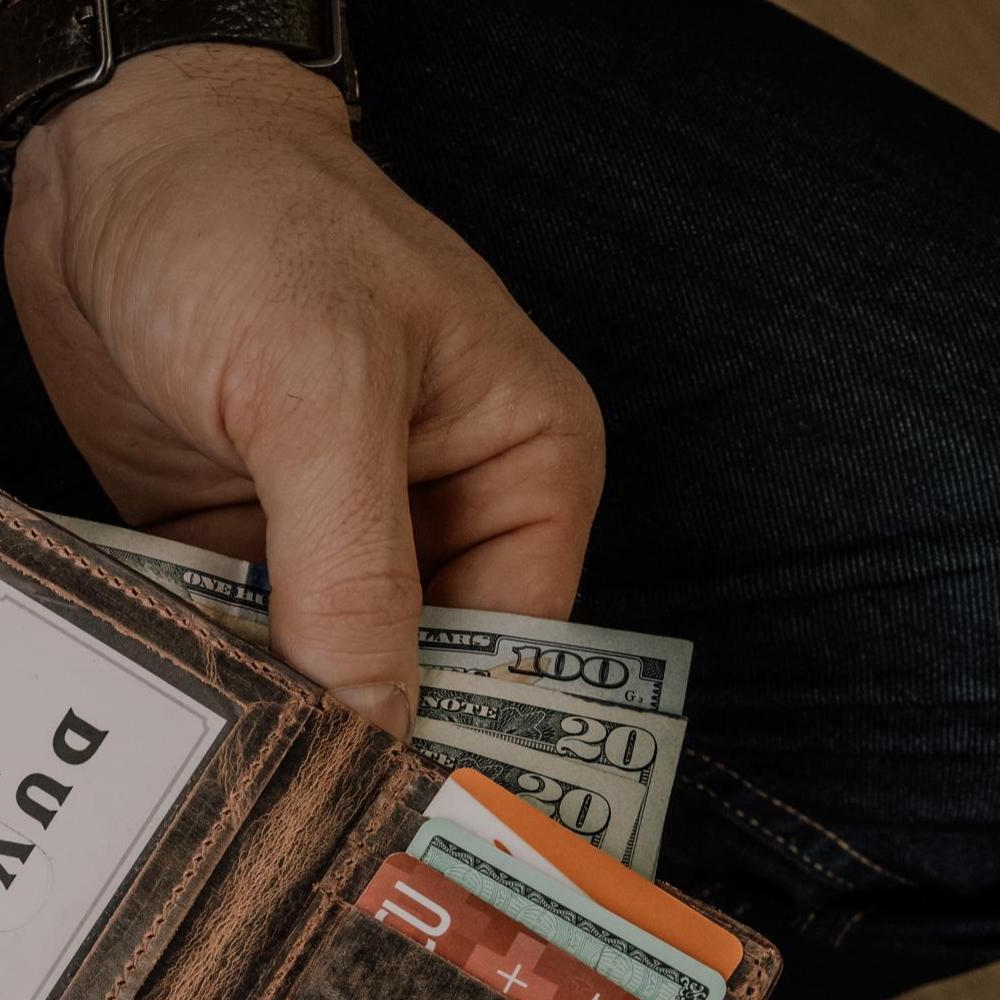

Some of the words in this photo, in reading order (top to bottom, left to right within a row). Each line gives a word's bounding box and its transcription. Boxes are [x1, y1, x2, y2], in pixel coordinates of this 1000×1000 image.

[183, 571, 232, 595] ONE
[508, 645, 629, 689] 100
[420, 695, 497, 719] NOTE
[556, 716, 657, 771] 20
[517, 773, 611, 835] 20
